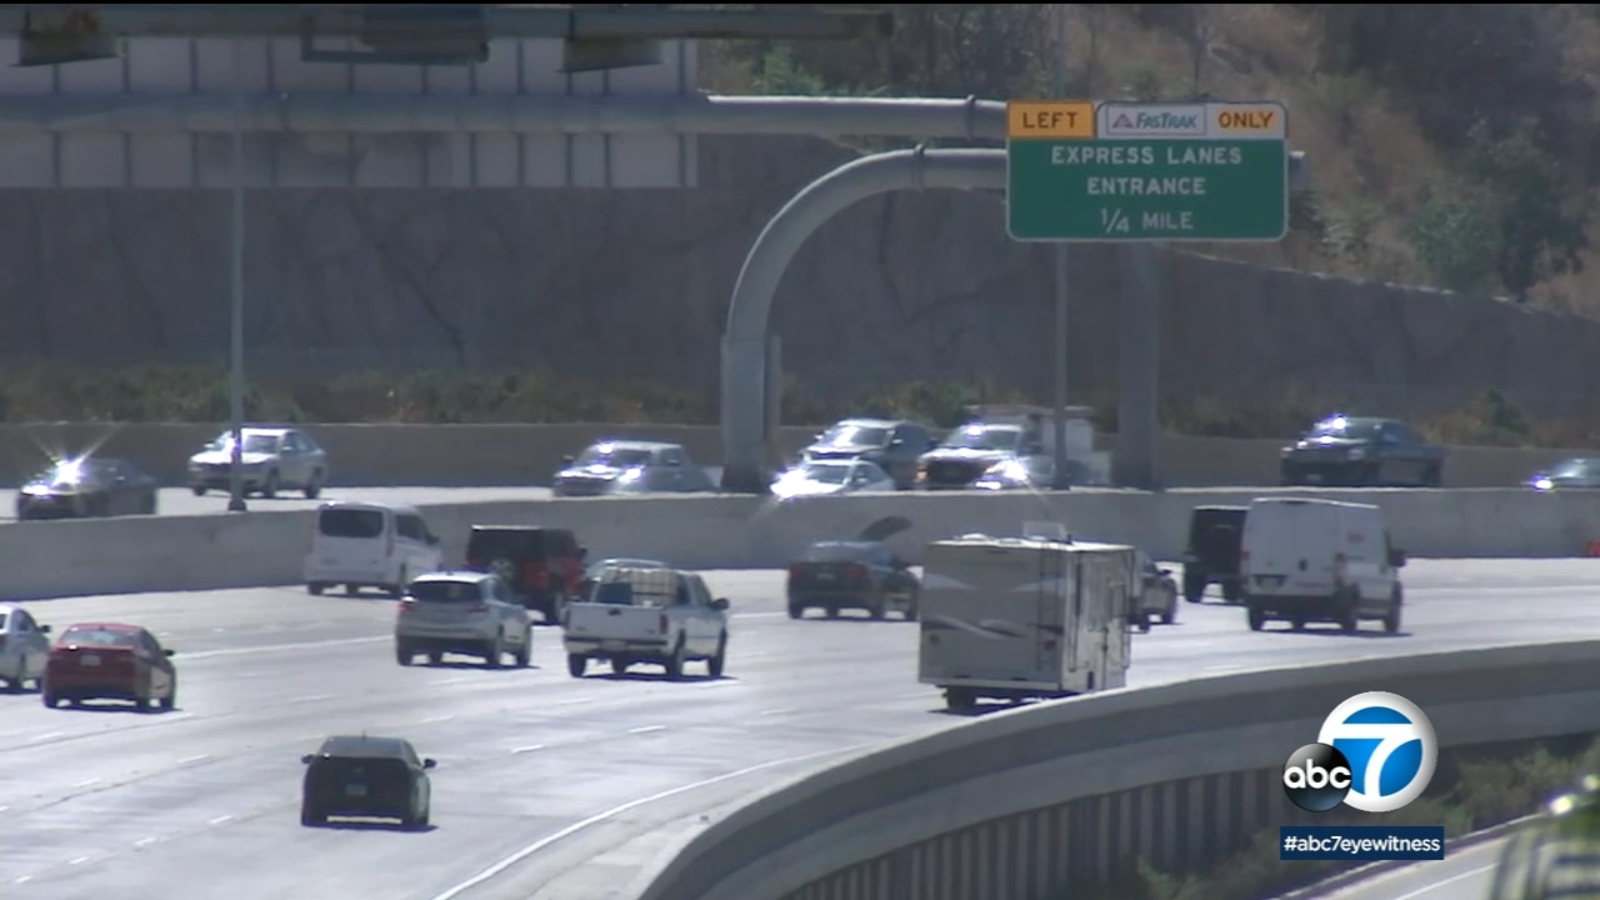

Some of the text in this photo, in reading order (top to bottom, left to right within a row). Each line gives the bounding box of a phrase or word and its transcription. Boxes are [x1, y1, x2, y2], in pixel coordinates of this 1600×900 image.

[1022, 112, 1078, 129] LEFT
[1218, 111, 1274, 129] ONLY
[1051, 147, 1242, 165] EXPRESS LANES
[1087, 178, 1206, 195] ENTRANCE
[1142, 212, 1194, 229] MILE
